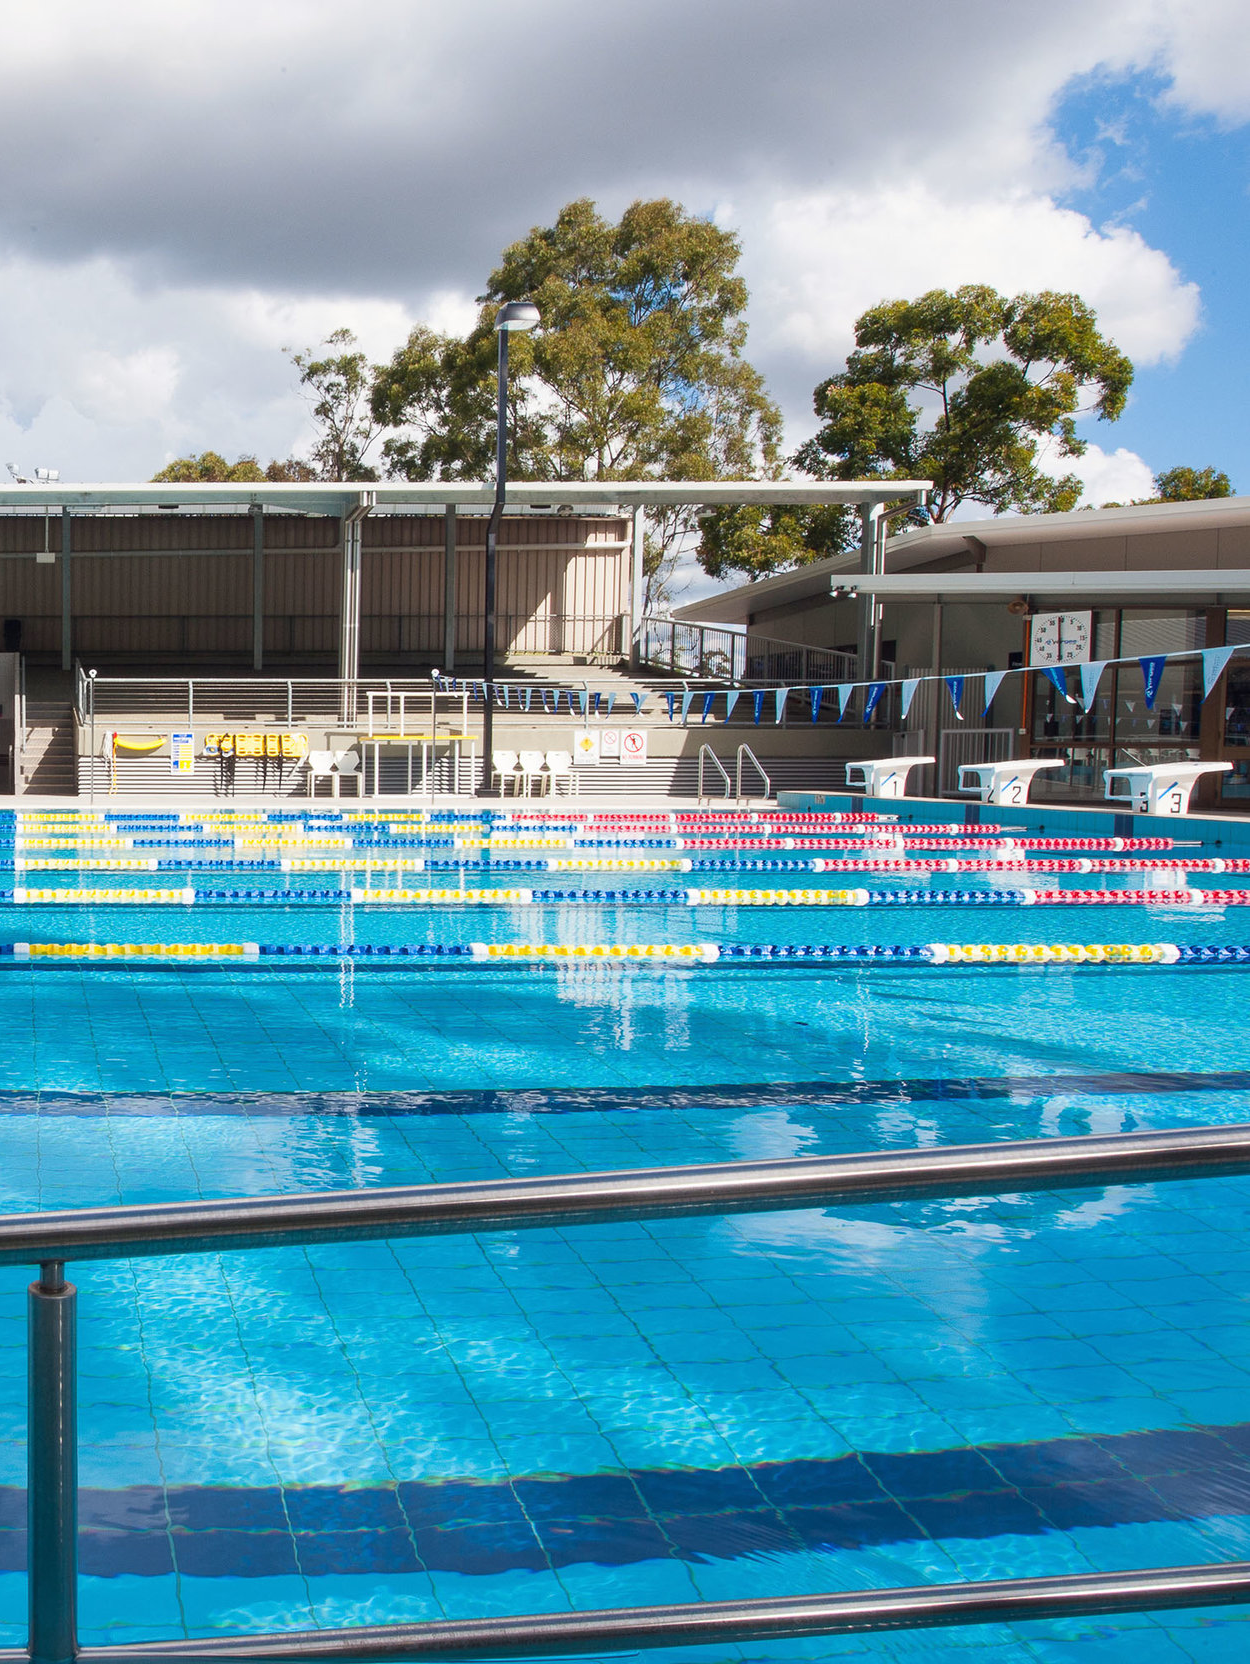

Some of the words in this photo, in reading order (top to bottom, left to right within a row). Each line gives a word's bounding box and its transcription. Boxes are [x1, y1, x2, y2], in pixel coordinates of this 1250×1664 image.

[893, 780, 897, 796] 1
[1012, 786, 1021, 804] 2
[1170, 793, 1182, 813] 3
